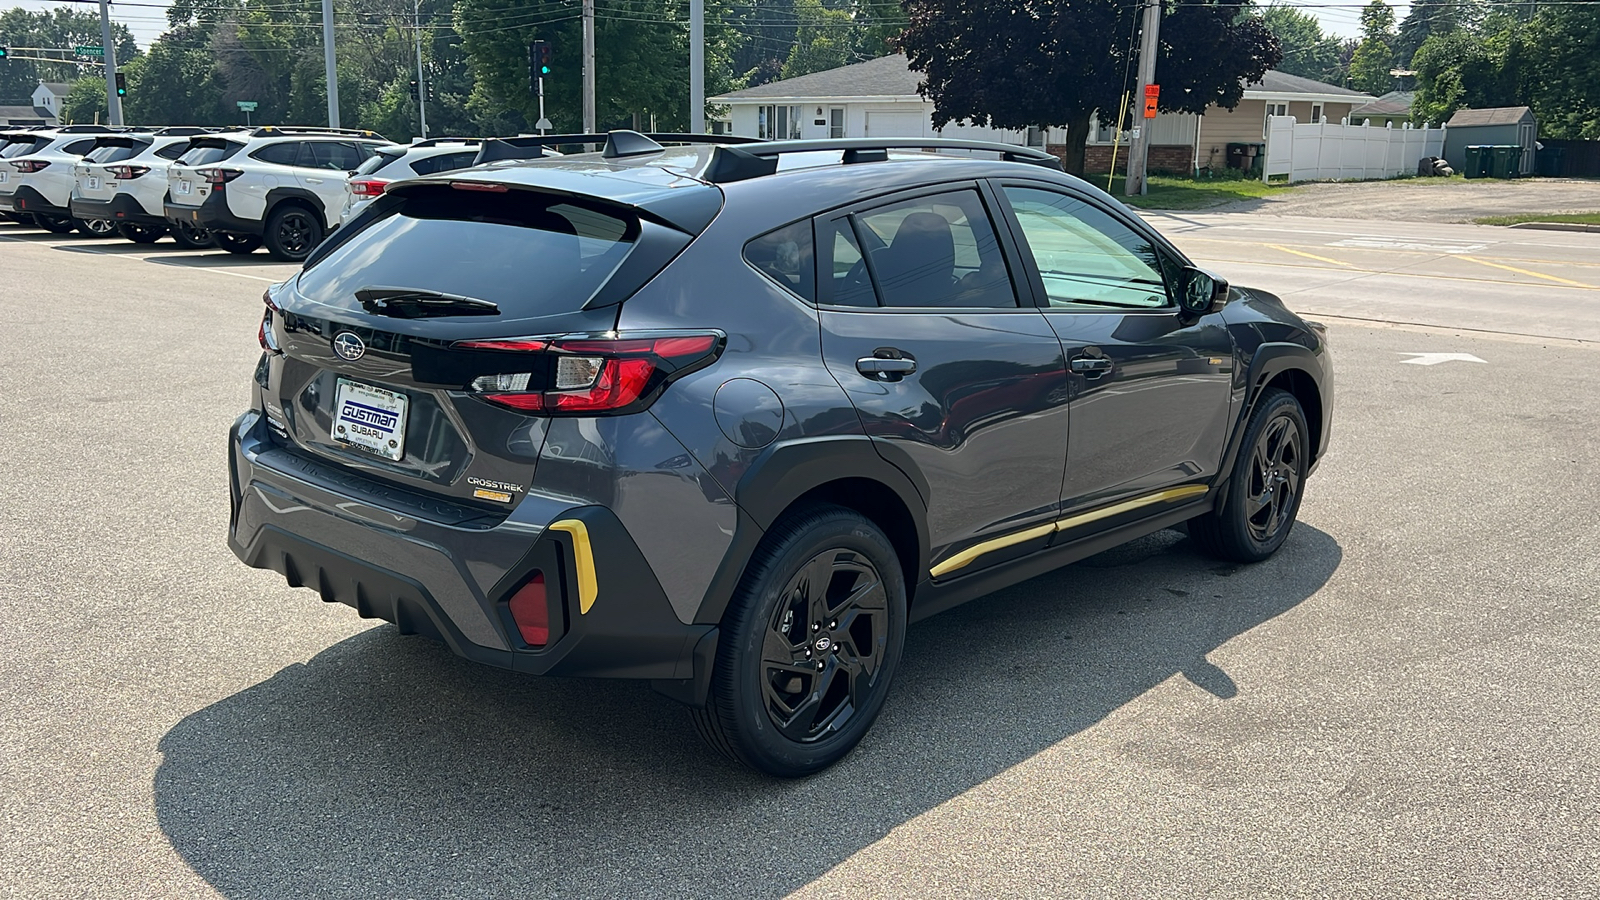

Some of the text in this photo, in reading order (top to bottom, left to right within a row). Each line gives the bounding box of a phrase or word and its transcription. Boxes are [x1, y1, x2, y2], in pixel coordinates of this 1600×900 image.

[351, 424, 384, 440] SUBARU
[467, 477, 523, 492] CROSSTREK
[477, 490, 508, 500] SPORT
